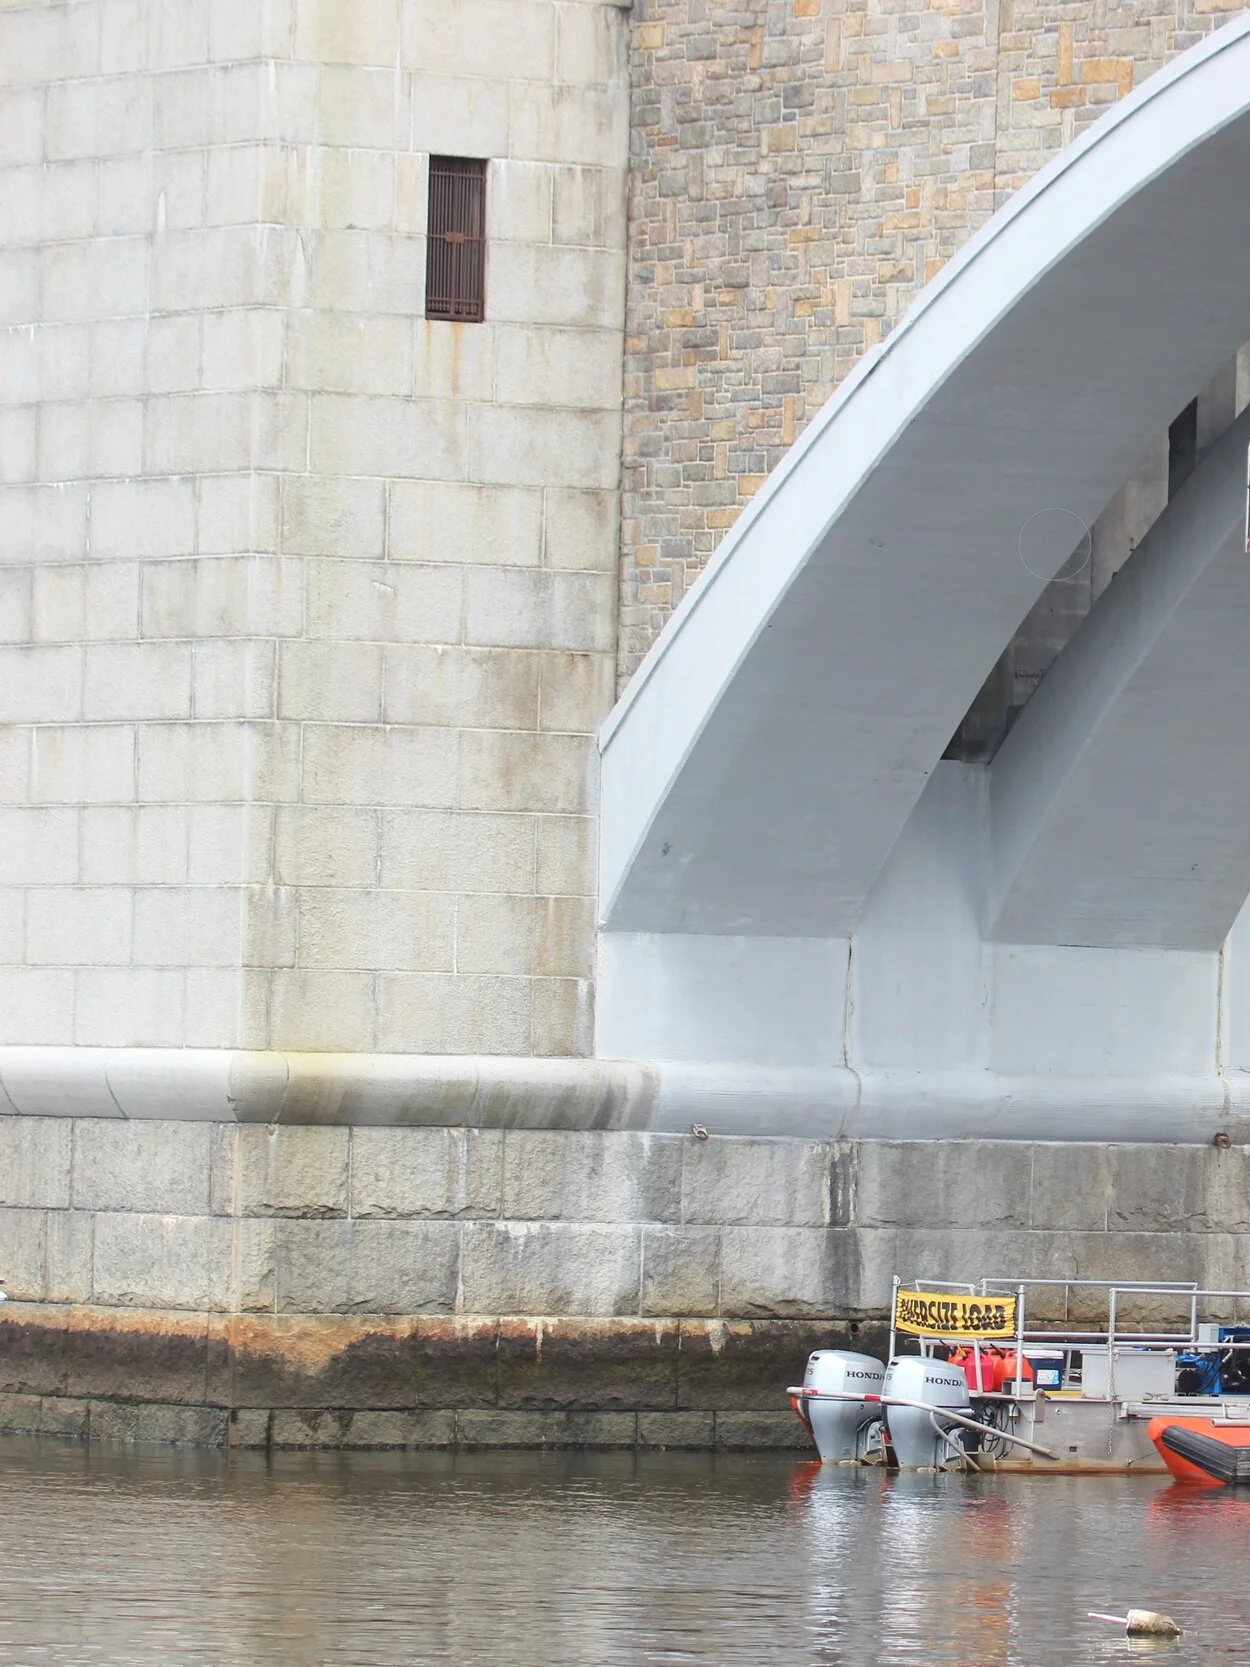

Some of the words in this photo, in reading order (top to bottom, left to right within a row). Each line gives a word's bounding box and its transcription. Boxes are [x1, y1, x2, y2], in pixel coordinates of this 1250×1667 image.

[962, 1303, 1007, 1330] LOAD
[846, 1371, 885, 1380] HONDA
[925, 1376, 965, 1387] HONDA
